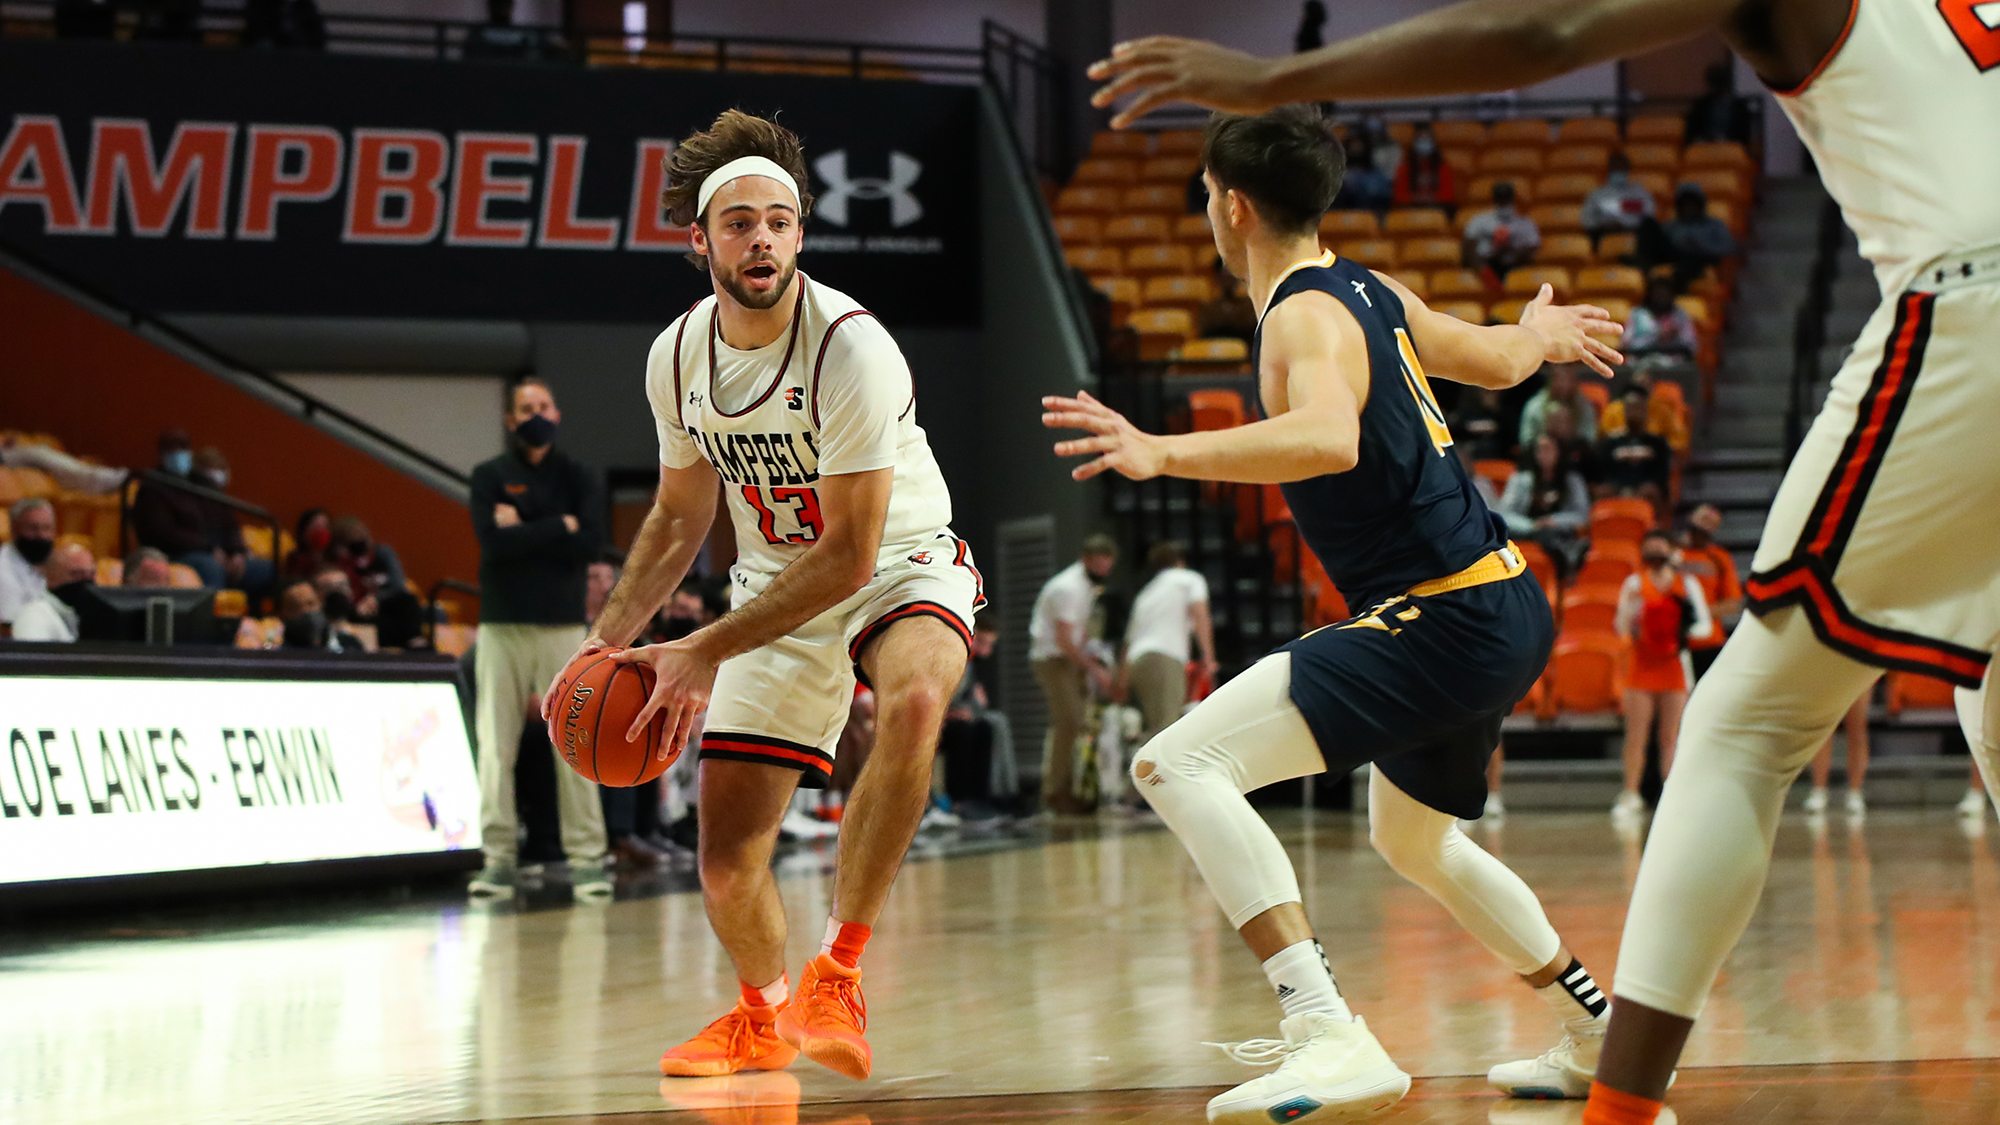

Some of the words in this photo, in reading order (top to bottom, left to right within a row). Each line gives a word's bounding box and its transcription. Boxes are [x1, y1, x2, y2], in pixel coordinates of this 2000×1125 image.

[0, 113, 693, 252] AMPBELL
[741, 485, 824, 545] 13
[71, 727, 200, 815] LANES
[221, 727, 344, 808] ERWIN
